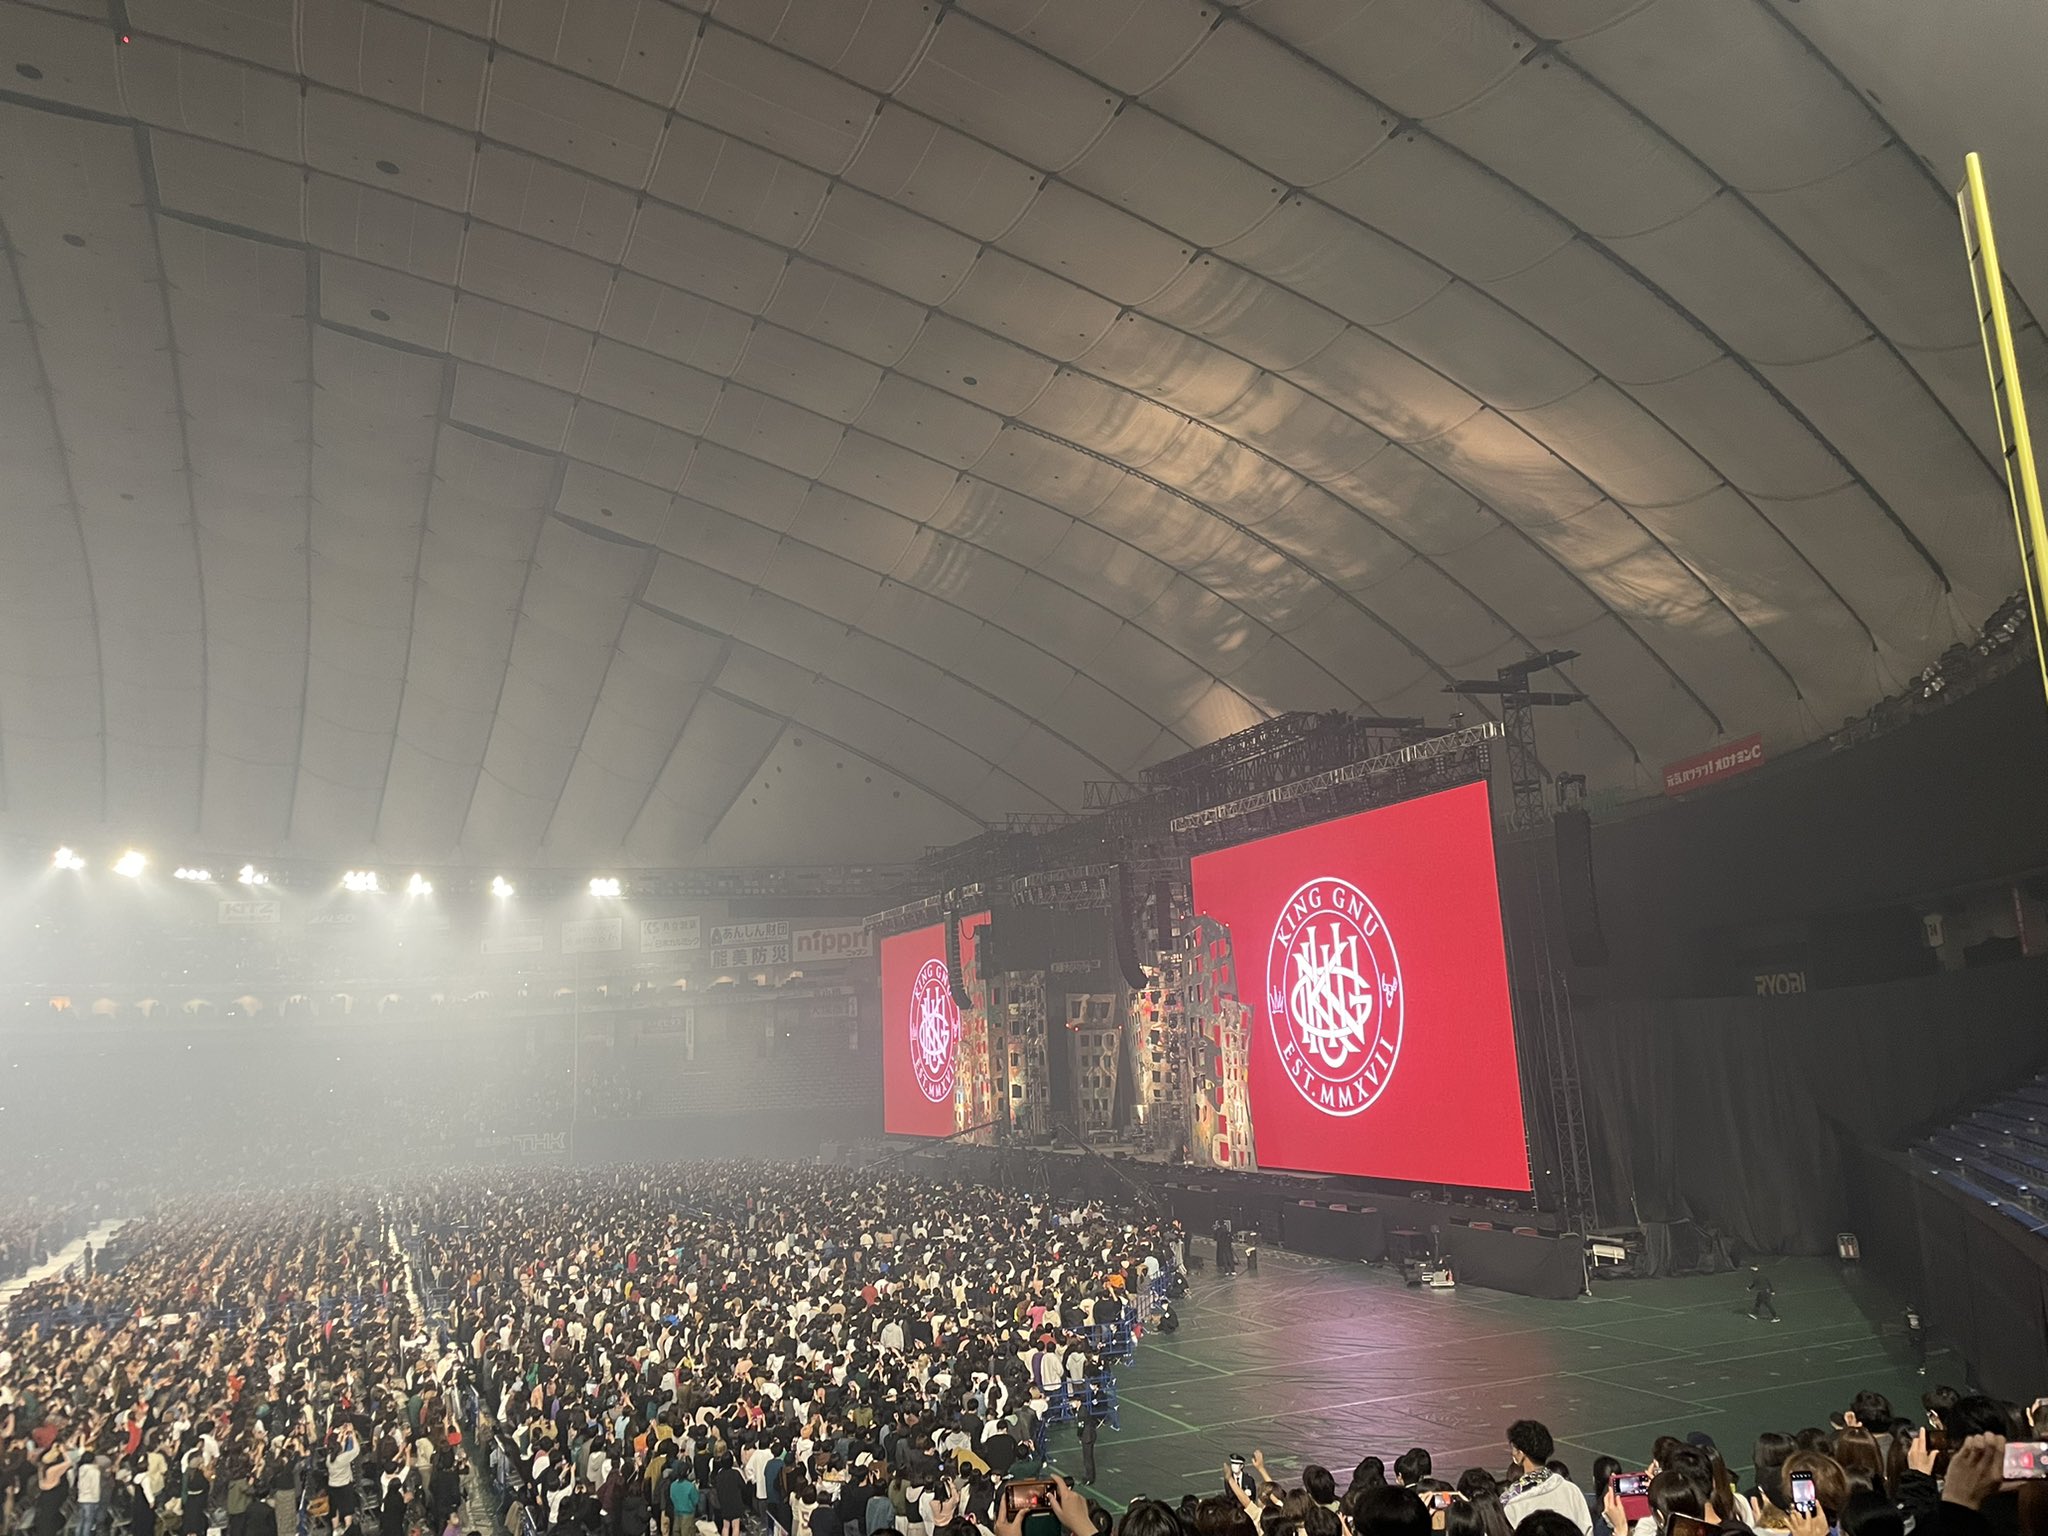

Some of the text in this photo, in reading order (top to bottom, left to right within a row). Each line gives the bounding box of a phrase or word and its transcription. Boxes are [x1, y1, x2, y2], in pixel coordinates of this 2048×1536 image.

[225, 902, 274, 914] KITZ
[1277, 887, 1379, 948] KING GNU
[723, 922, 788, 940] あんしん財団
[713, 945, 787, 967] 能美防災
[914, 964, 933, 1000] KING
[1754, 971, 1807, 998] RYOBI
[512, 1132, 567, 1153] THK
